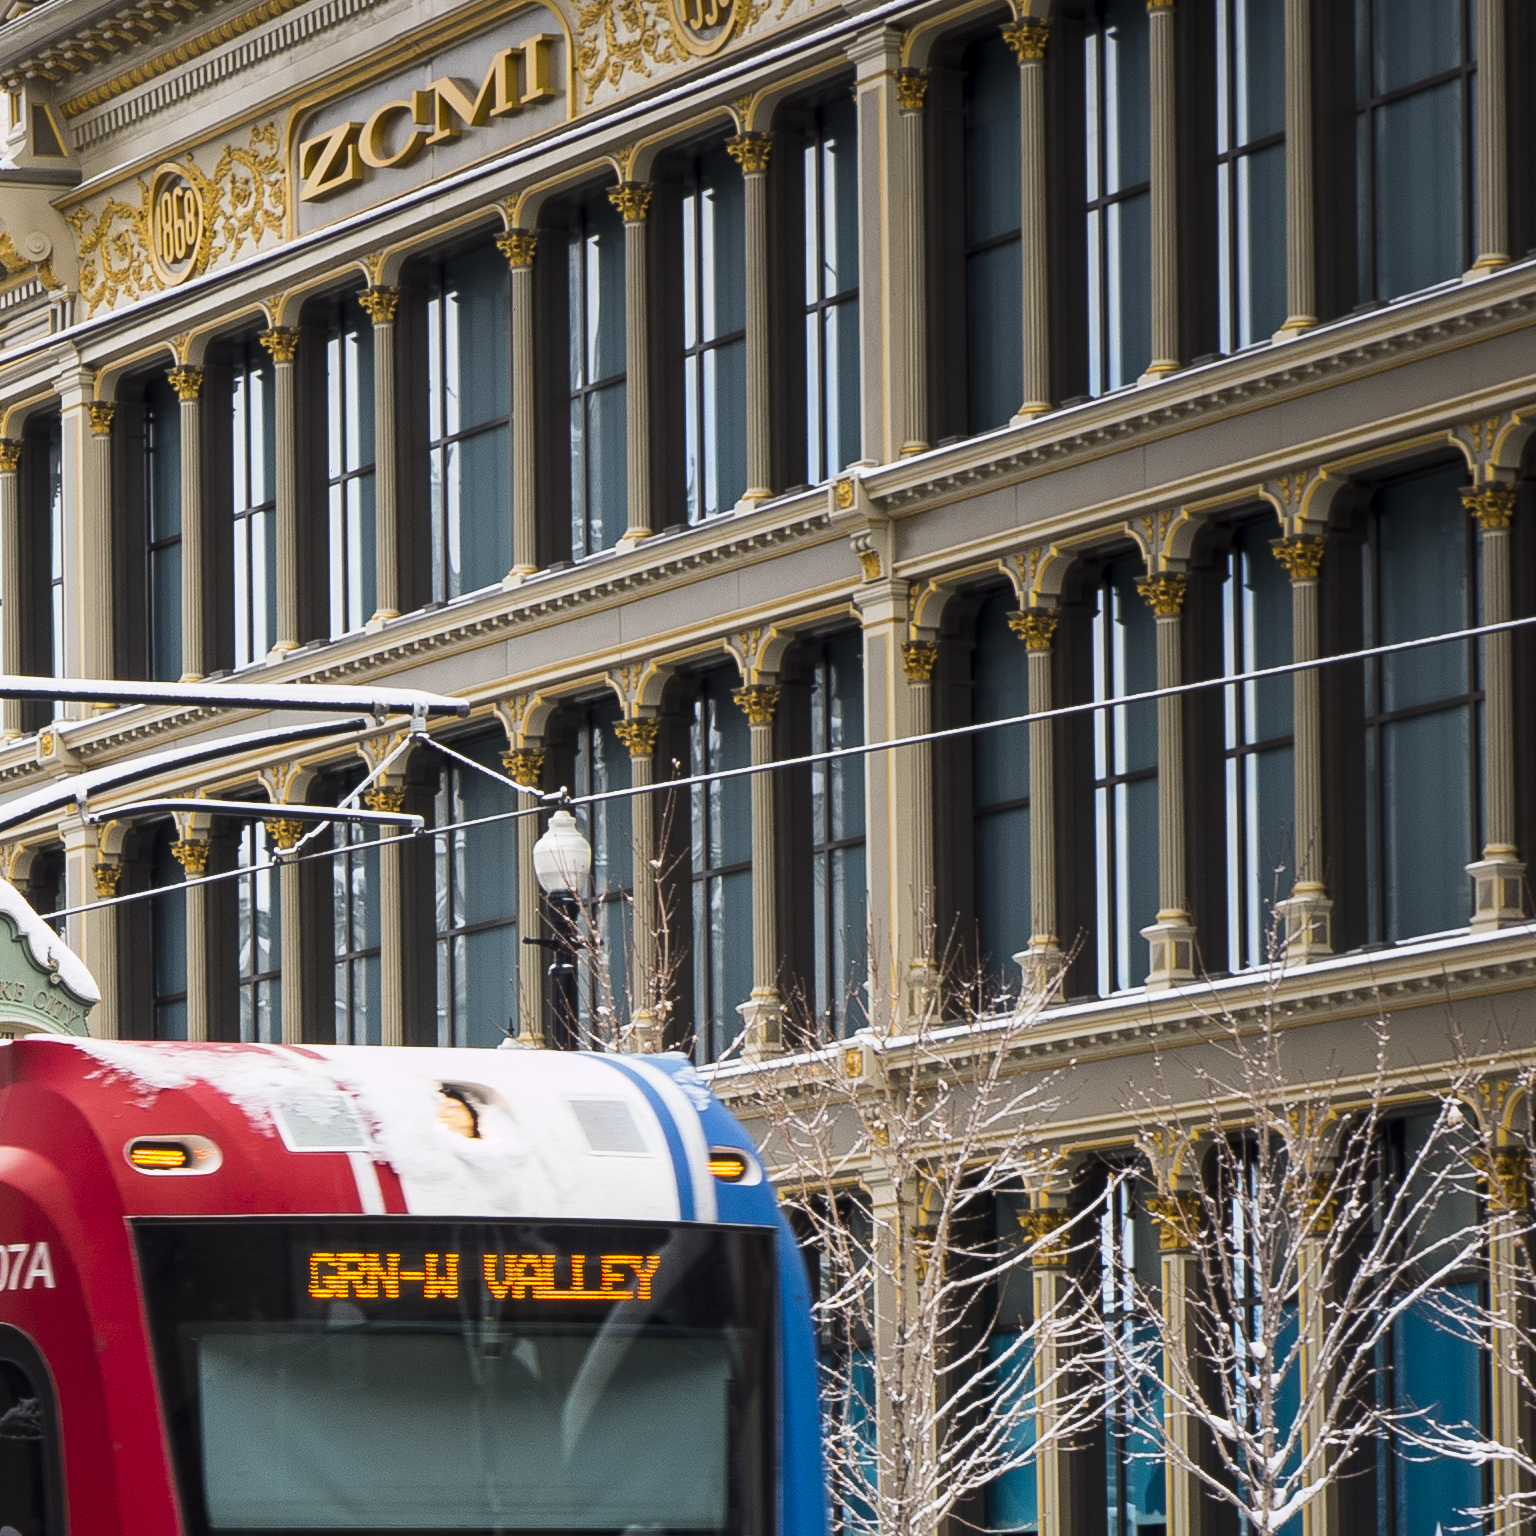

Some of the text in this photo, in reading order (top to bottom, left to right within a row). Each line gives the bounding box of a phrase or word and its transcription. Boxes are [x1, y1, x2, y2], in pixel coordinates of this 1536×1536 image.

[299, 33, 556, 203] ZCMI
[155, 185, 197, 265] 1868
[33, 990, 81, 1028] CITY
[308, 1252, 662, 1301] GRN-W VALLEY
